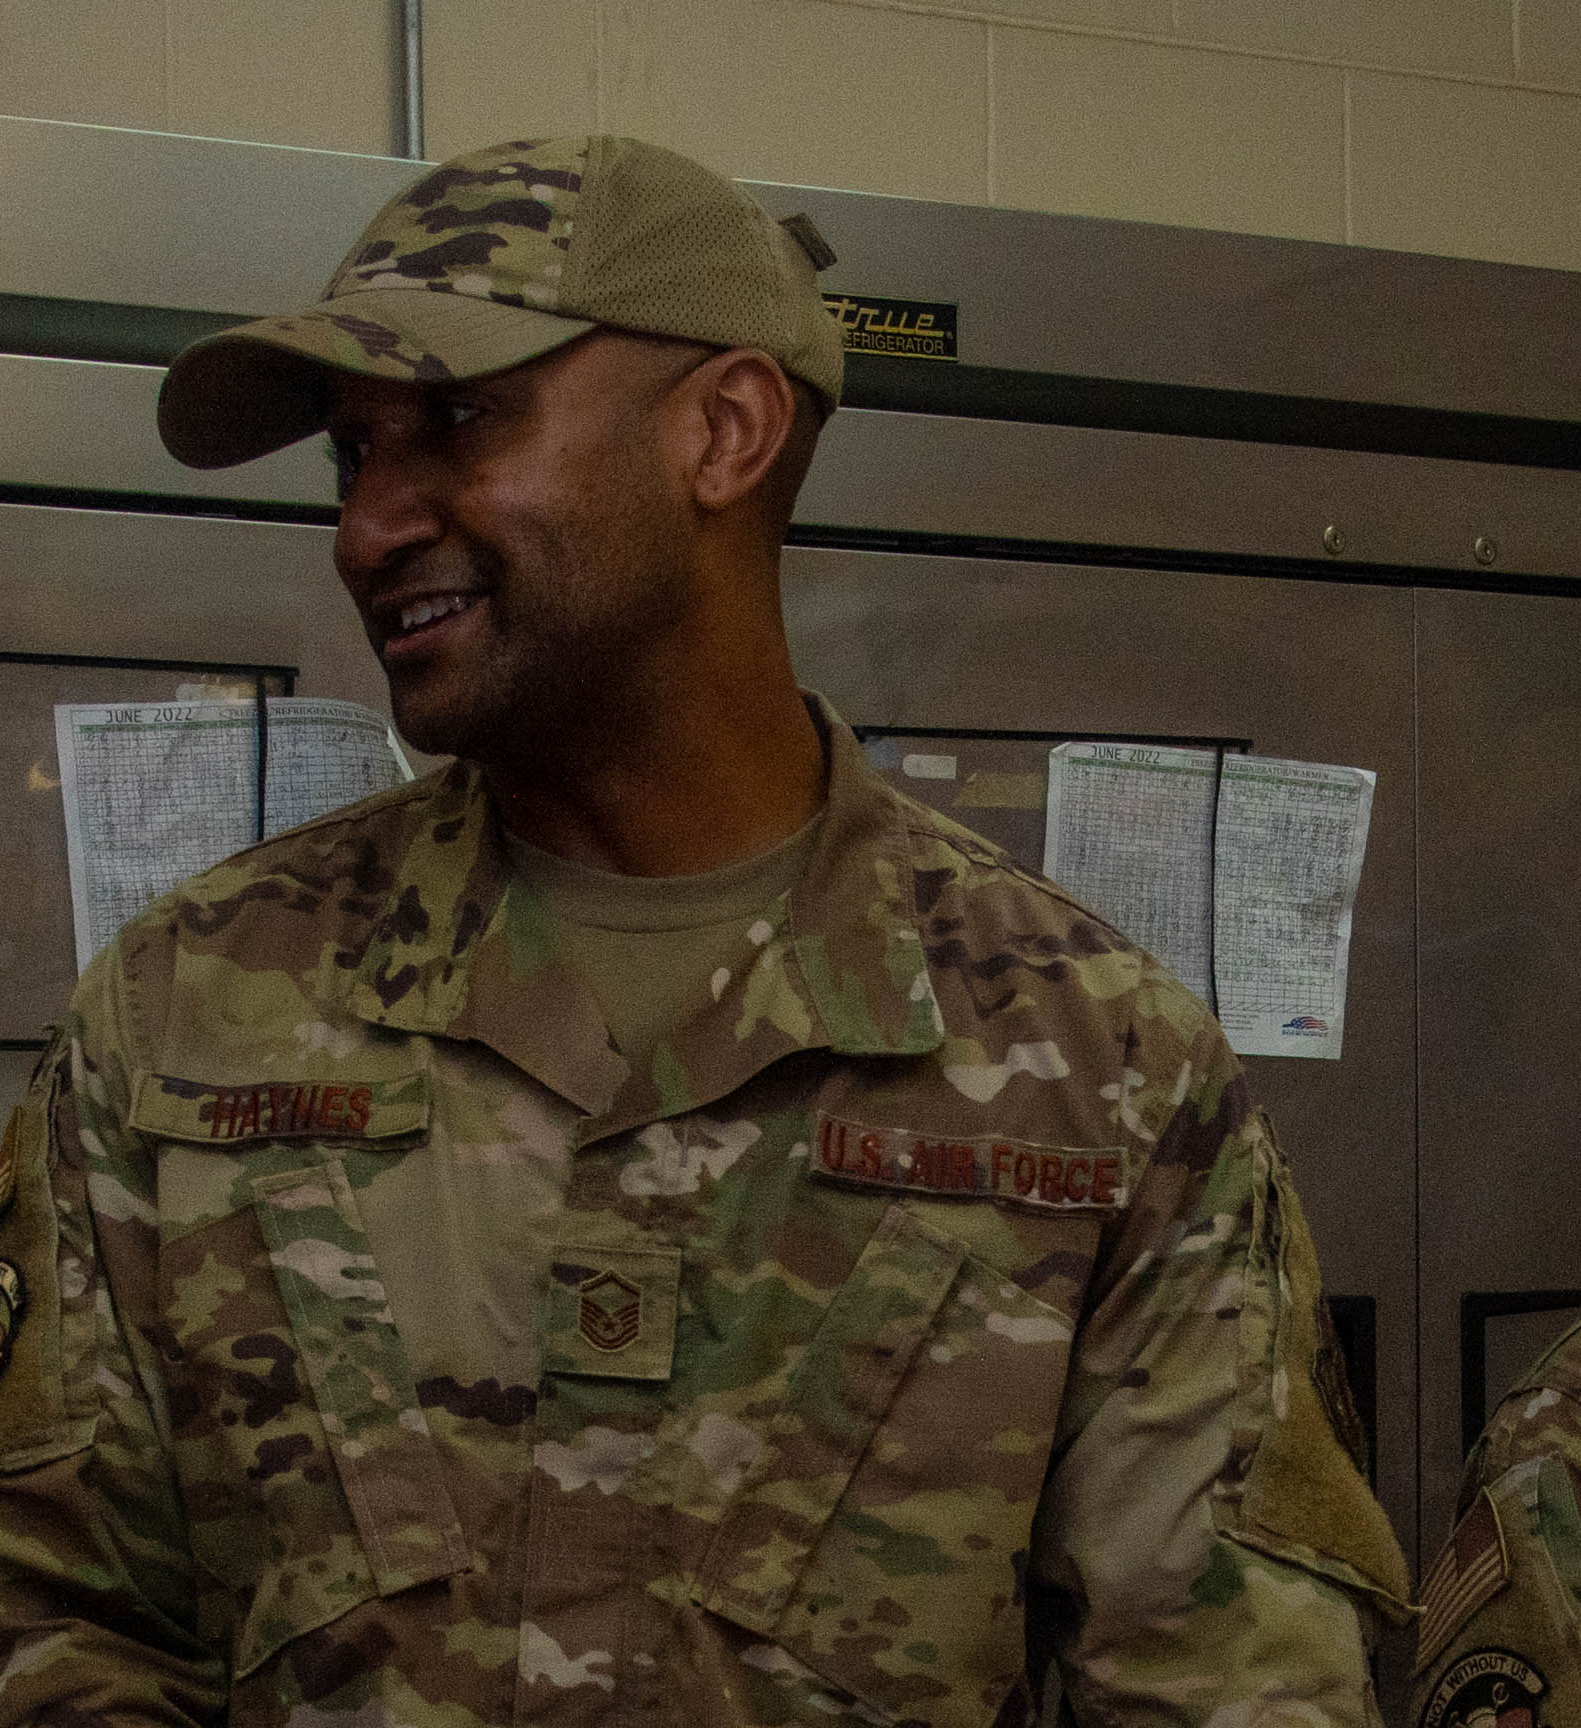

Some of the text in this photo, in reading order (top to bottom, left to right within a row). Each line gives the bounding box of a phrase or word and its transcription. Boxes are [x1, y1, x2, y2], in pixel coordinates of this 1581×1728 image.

[844, 331, 945, 354] EFRIGERATOR
[106, 707, 192, 723] JUNE 2022
[1092, 745, 1160, 764] JUNE 2022
[211, 1085, 373, 1138] HAYNES
[822, 1121, 1119, 1203] U.S. AIR FORCE
[1427, 1657, 1529, 1728] NOT WITHOUT US
